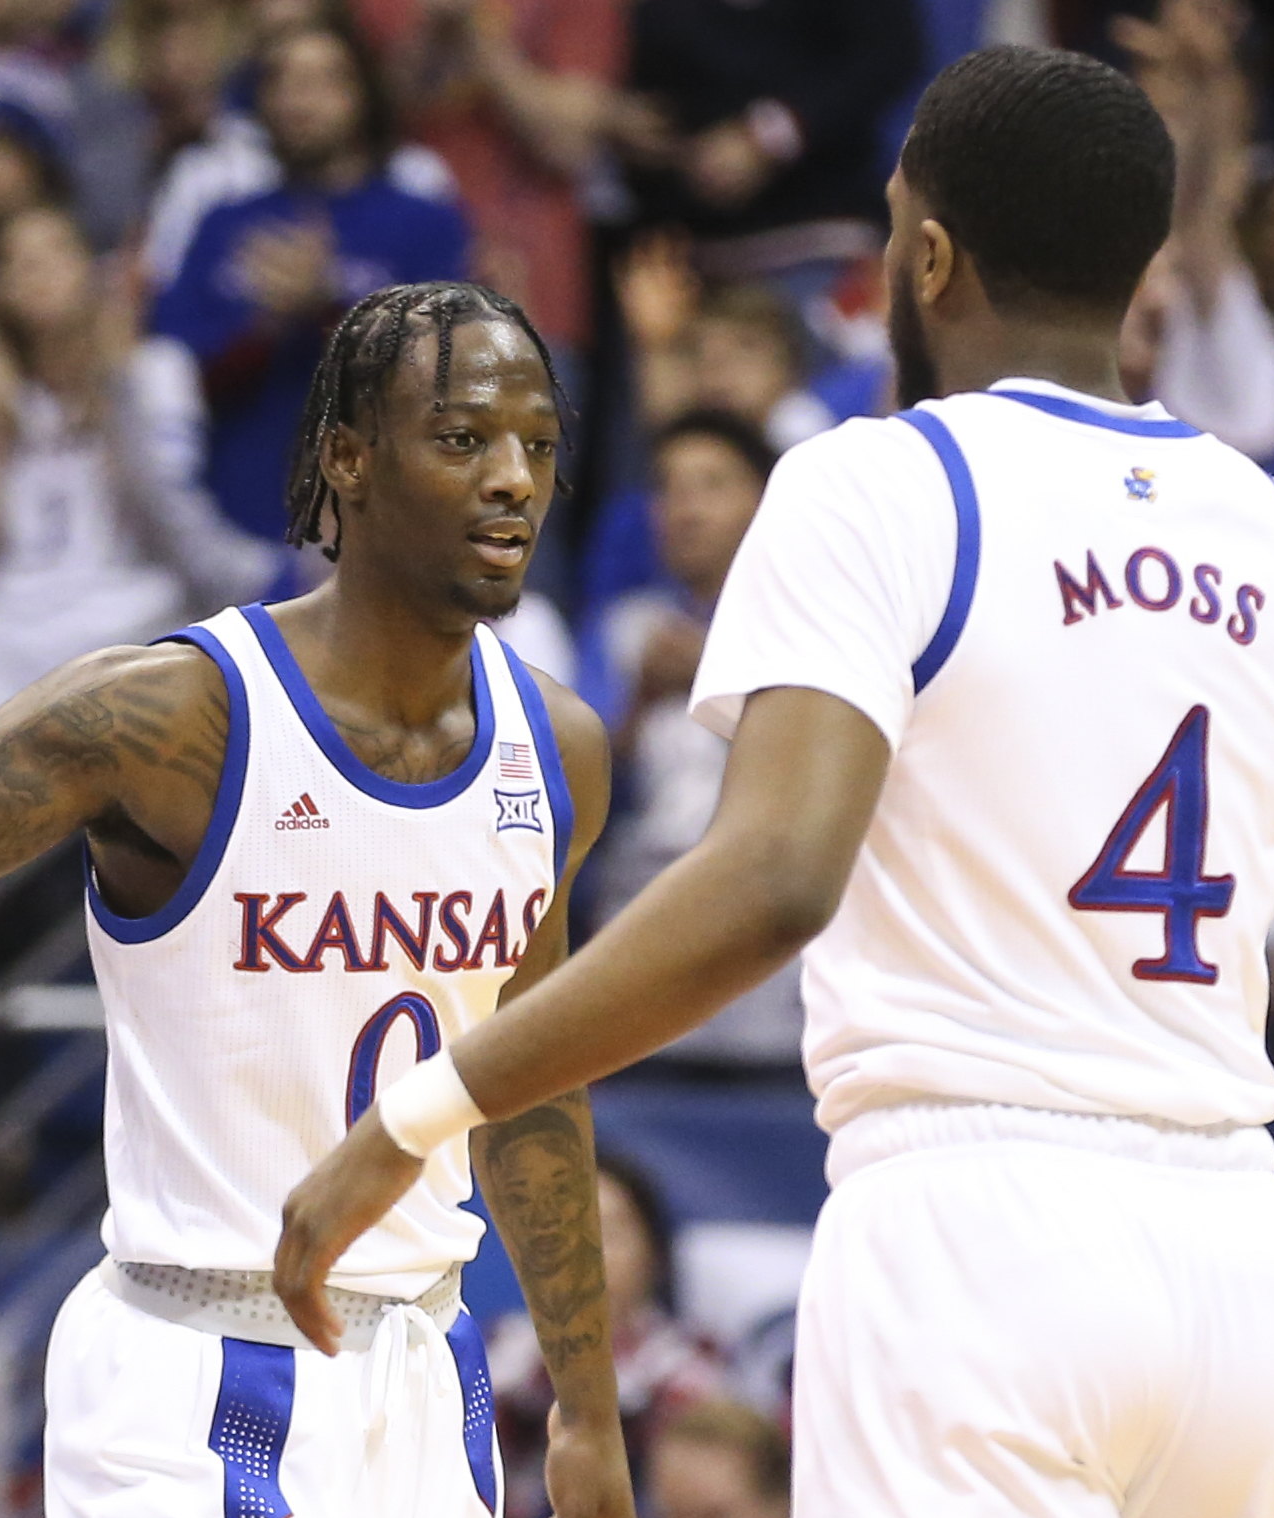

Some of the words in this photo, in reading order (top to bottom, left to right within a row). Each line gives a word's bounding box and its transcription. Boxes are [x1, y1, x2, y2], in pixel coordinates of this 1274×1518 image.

[1054, 546, 1264, 645] MOSS
[274, 816, 331, 831] adidas
[1068, 703, 1235, 985] 4
[233, 887, 547, 973] KANSAS
